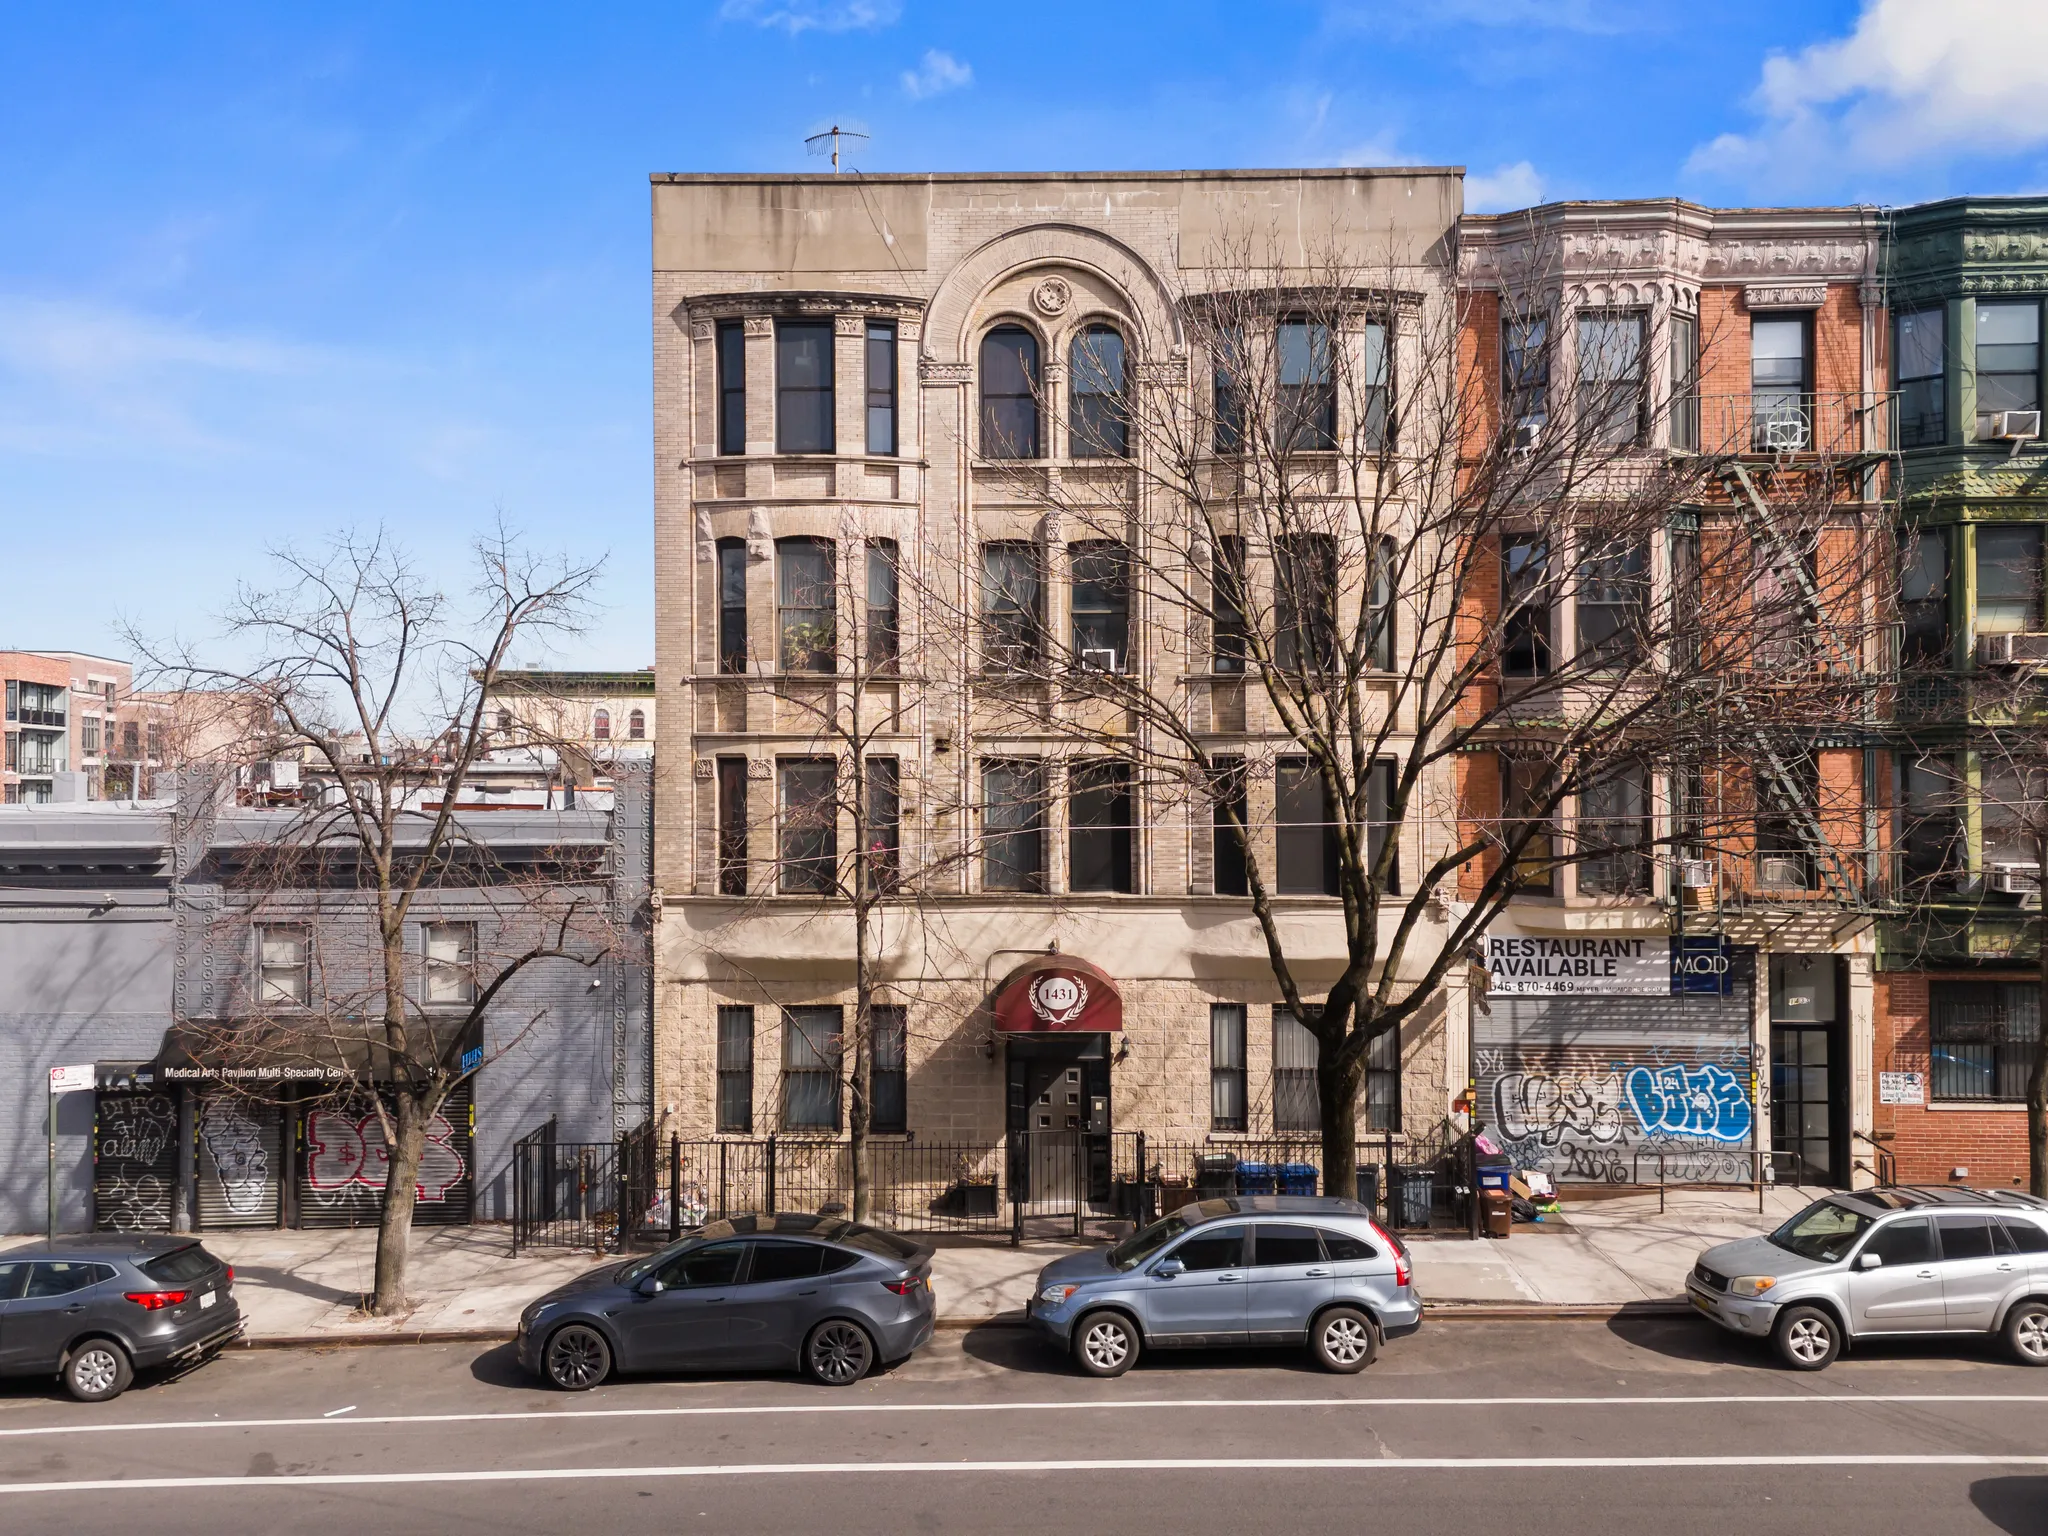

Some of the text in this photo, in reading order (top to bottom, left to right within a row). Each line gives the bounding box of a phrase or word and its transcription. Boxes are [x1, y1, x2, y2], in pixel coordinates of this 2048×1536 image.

[1490, 938, 1645, 958] RESTAURANT
[1490, 958, 1617, 977] AVAILABLE
[1674, 955, 1729, 974] MOD
[1044, 988, 1073, 1000] 1431
[165, 1067, 200, 1078] Medical
[201, 1067, 220, 1078] Arts
[222, 1067, 257, 1078] Pavilion
[1663, 1076, 1681, 1090] 24
